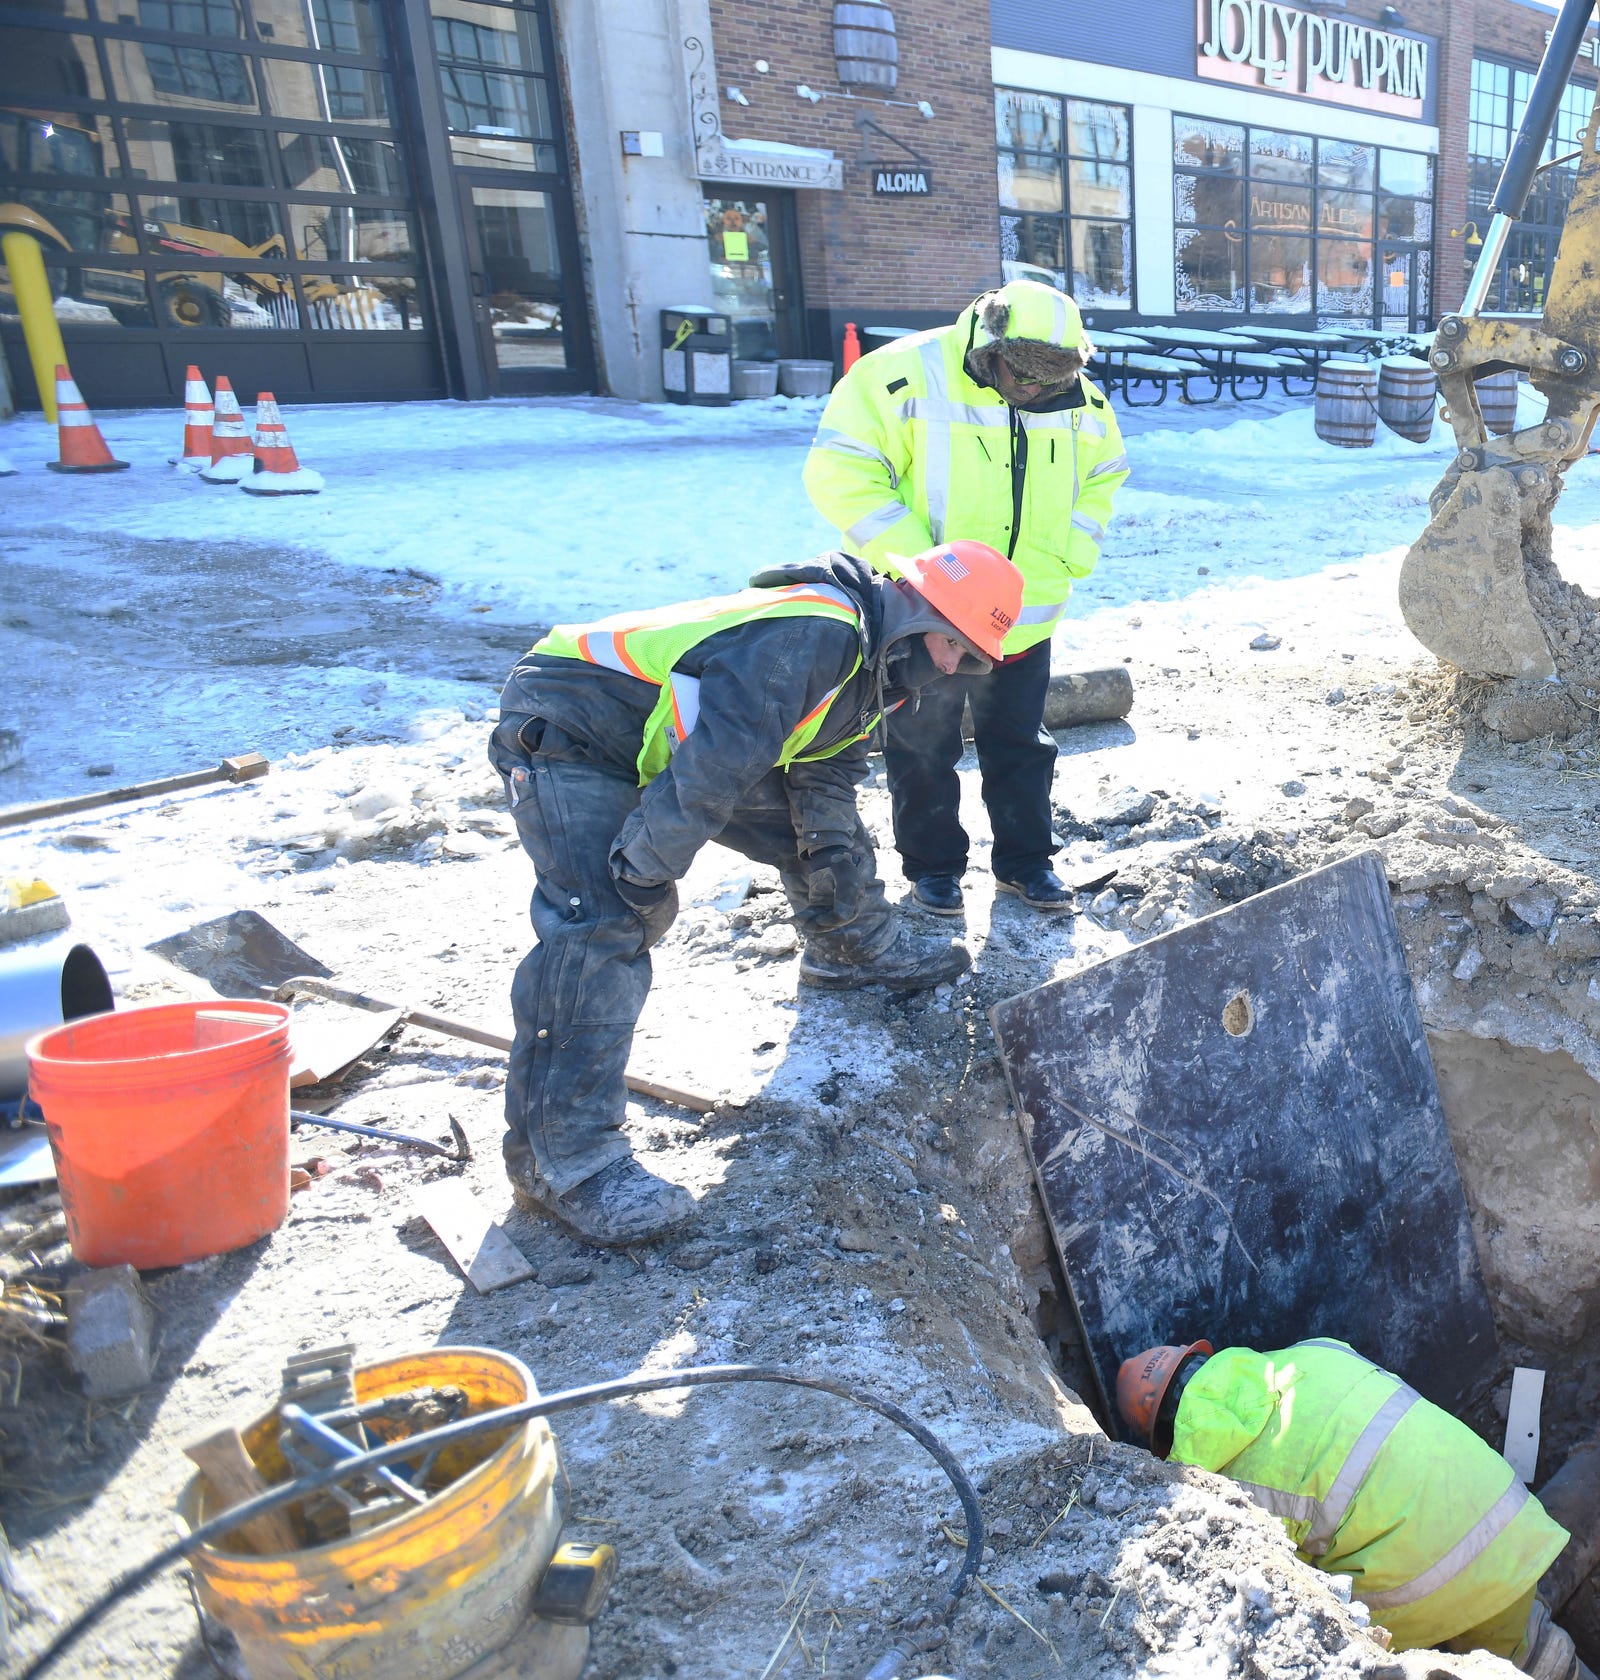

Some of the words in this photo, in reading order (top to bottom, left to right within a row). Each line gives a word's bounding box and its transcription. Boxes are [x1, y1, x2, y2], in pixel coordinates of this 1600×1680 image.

[1203, 0, 1304, 88] JOLLY
[1306, 14, 1428, 100] PUMPKIN
[876, 173, 928, 193] ALOHA
[990, 606, 1014, 629] LiUN
